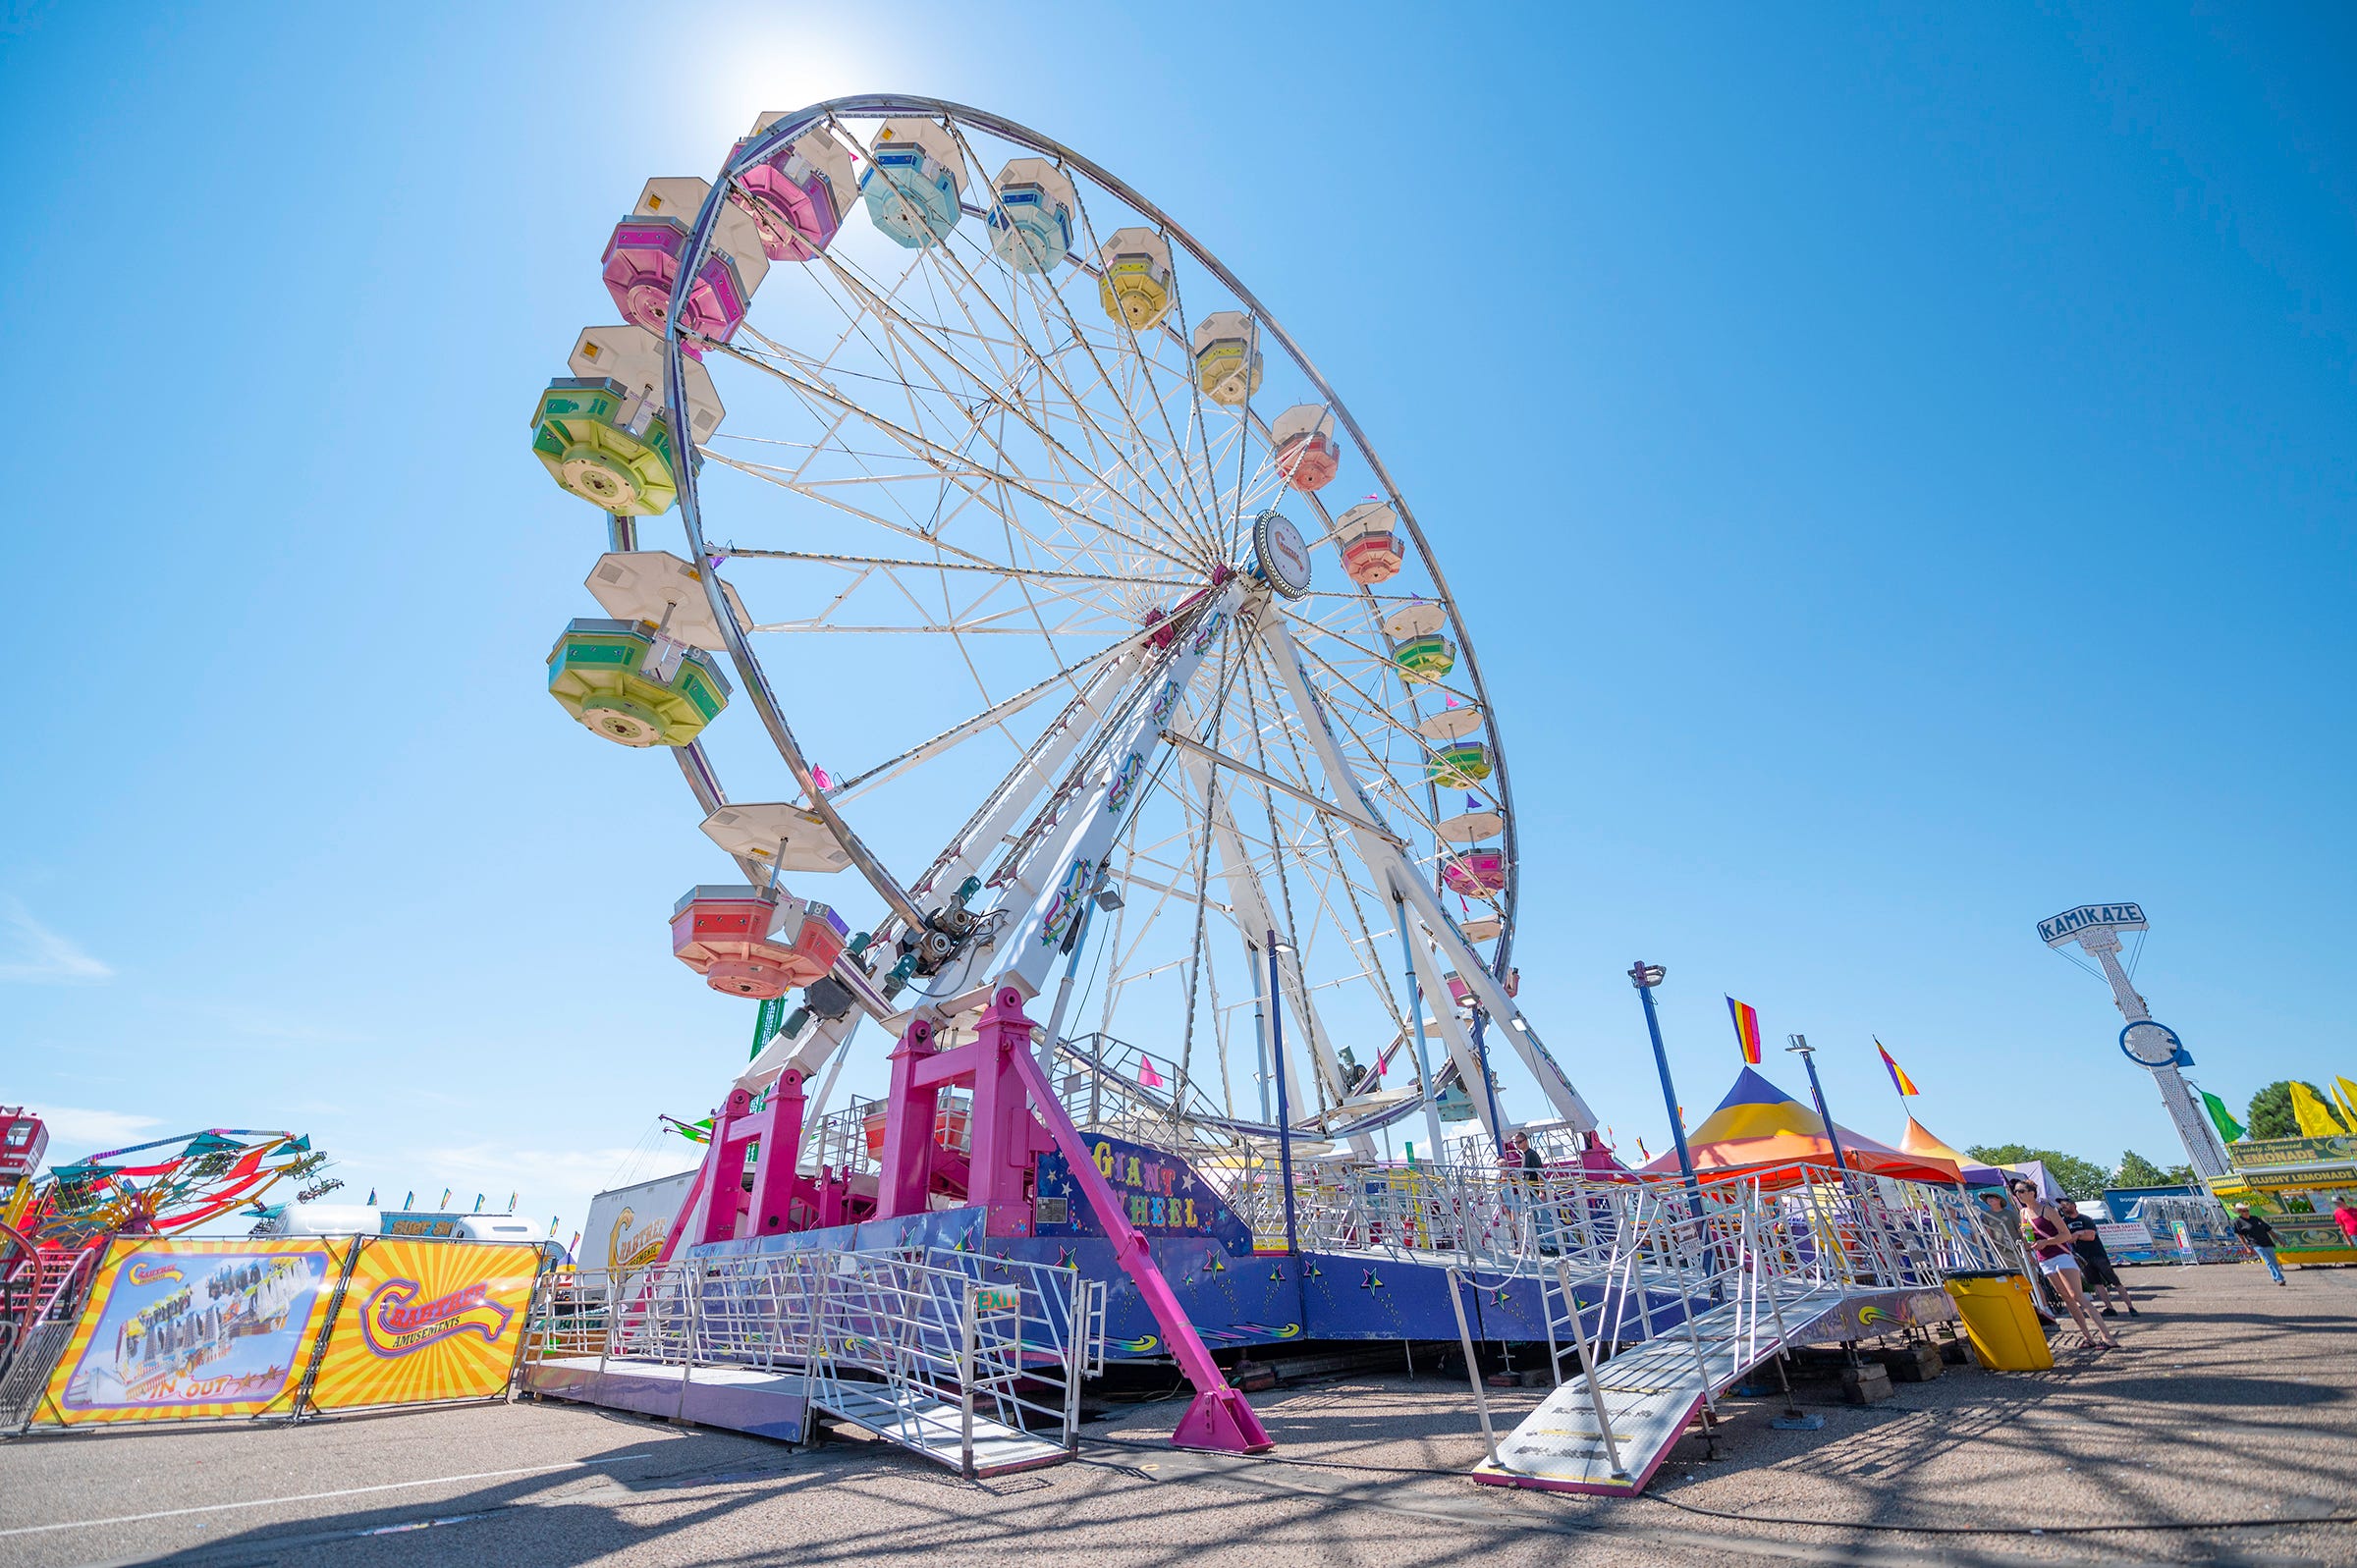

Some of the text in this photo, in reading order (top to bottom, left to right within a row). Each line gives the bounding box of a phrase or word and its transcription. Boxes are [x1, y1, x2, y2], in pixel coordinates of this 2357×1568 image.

[718, 248, 730, 262] 11
[692, 648, 701, 659] 9
[814, 903, 824, 914] 8
[2040, 905, 2142, 940] KAMIKAZE
[2236, 1149, 2319, 1164] LEMONADE
[1092, 1141, 1177, 1198] GIANT
[2250, 1169, 2354, 1186] SLUSHY LEMONADE
[392, 1220, 431, 1235] SURF
[362, 1279, 489, 1354] CRABTREE
[392, 1316, 461, 1349] AMUSEMENTS
[186, 1377, 230, 1398] OUT
